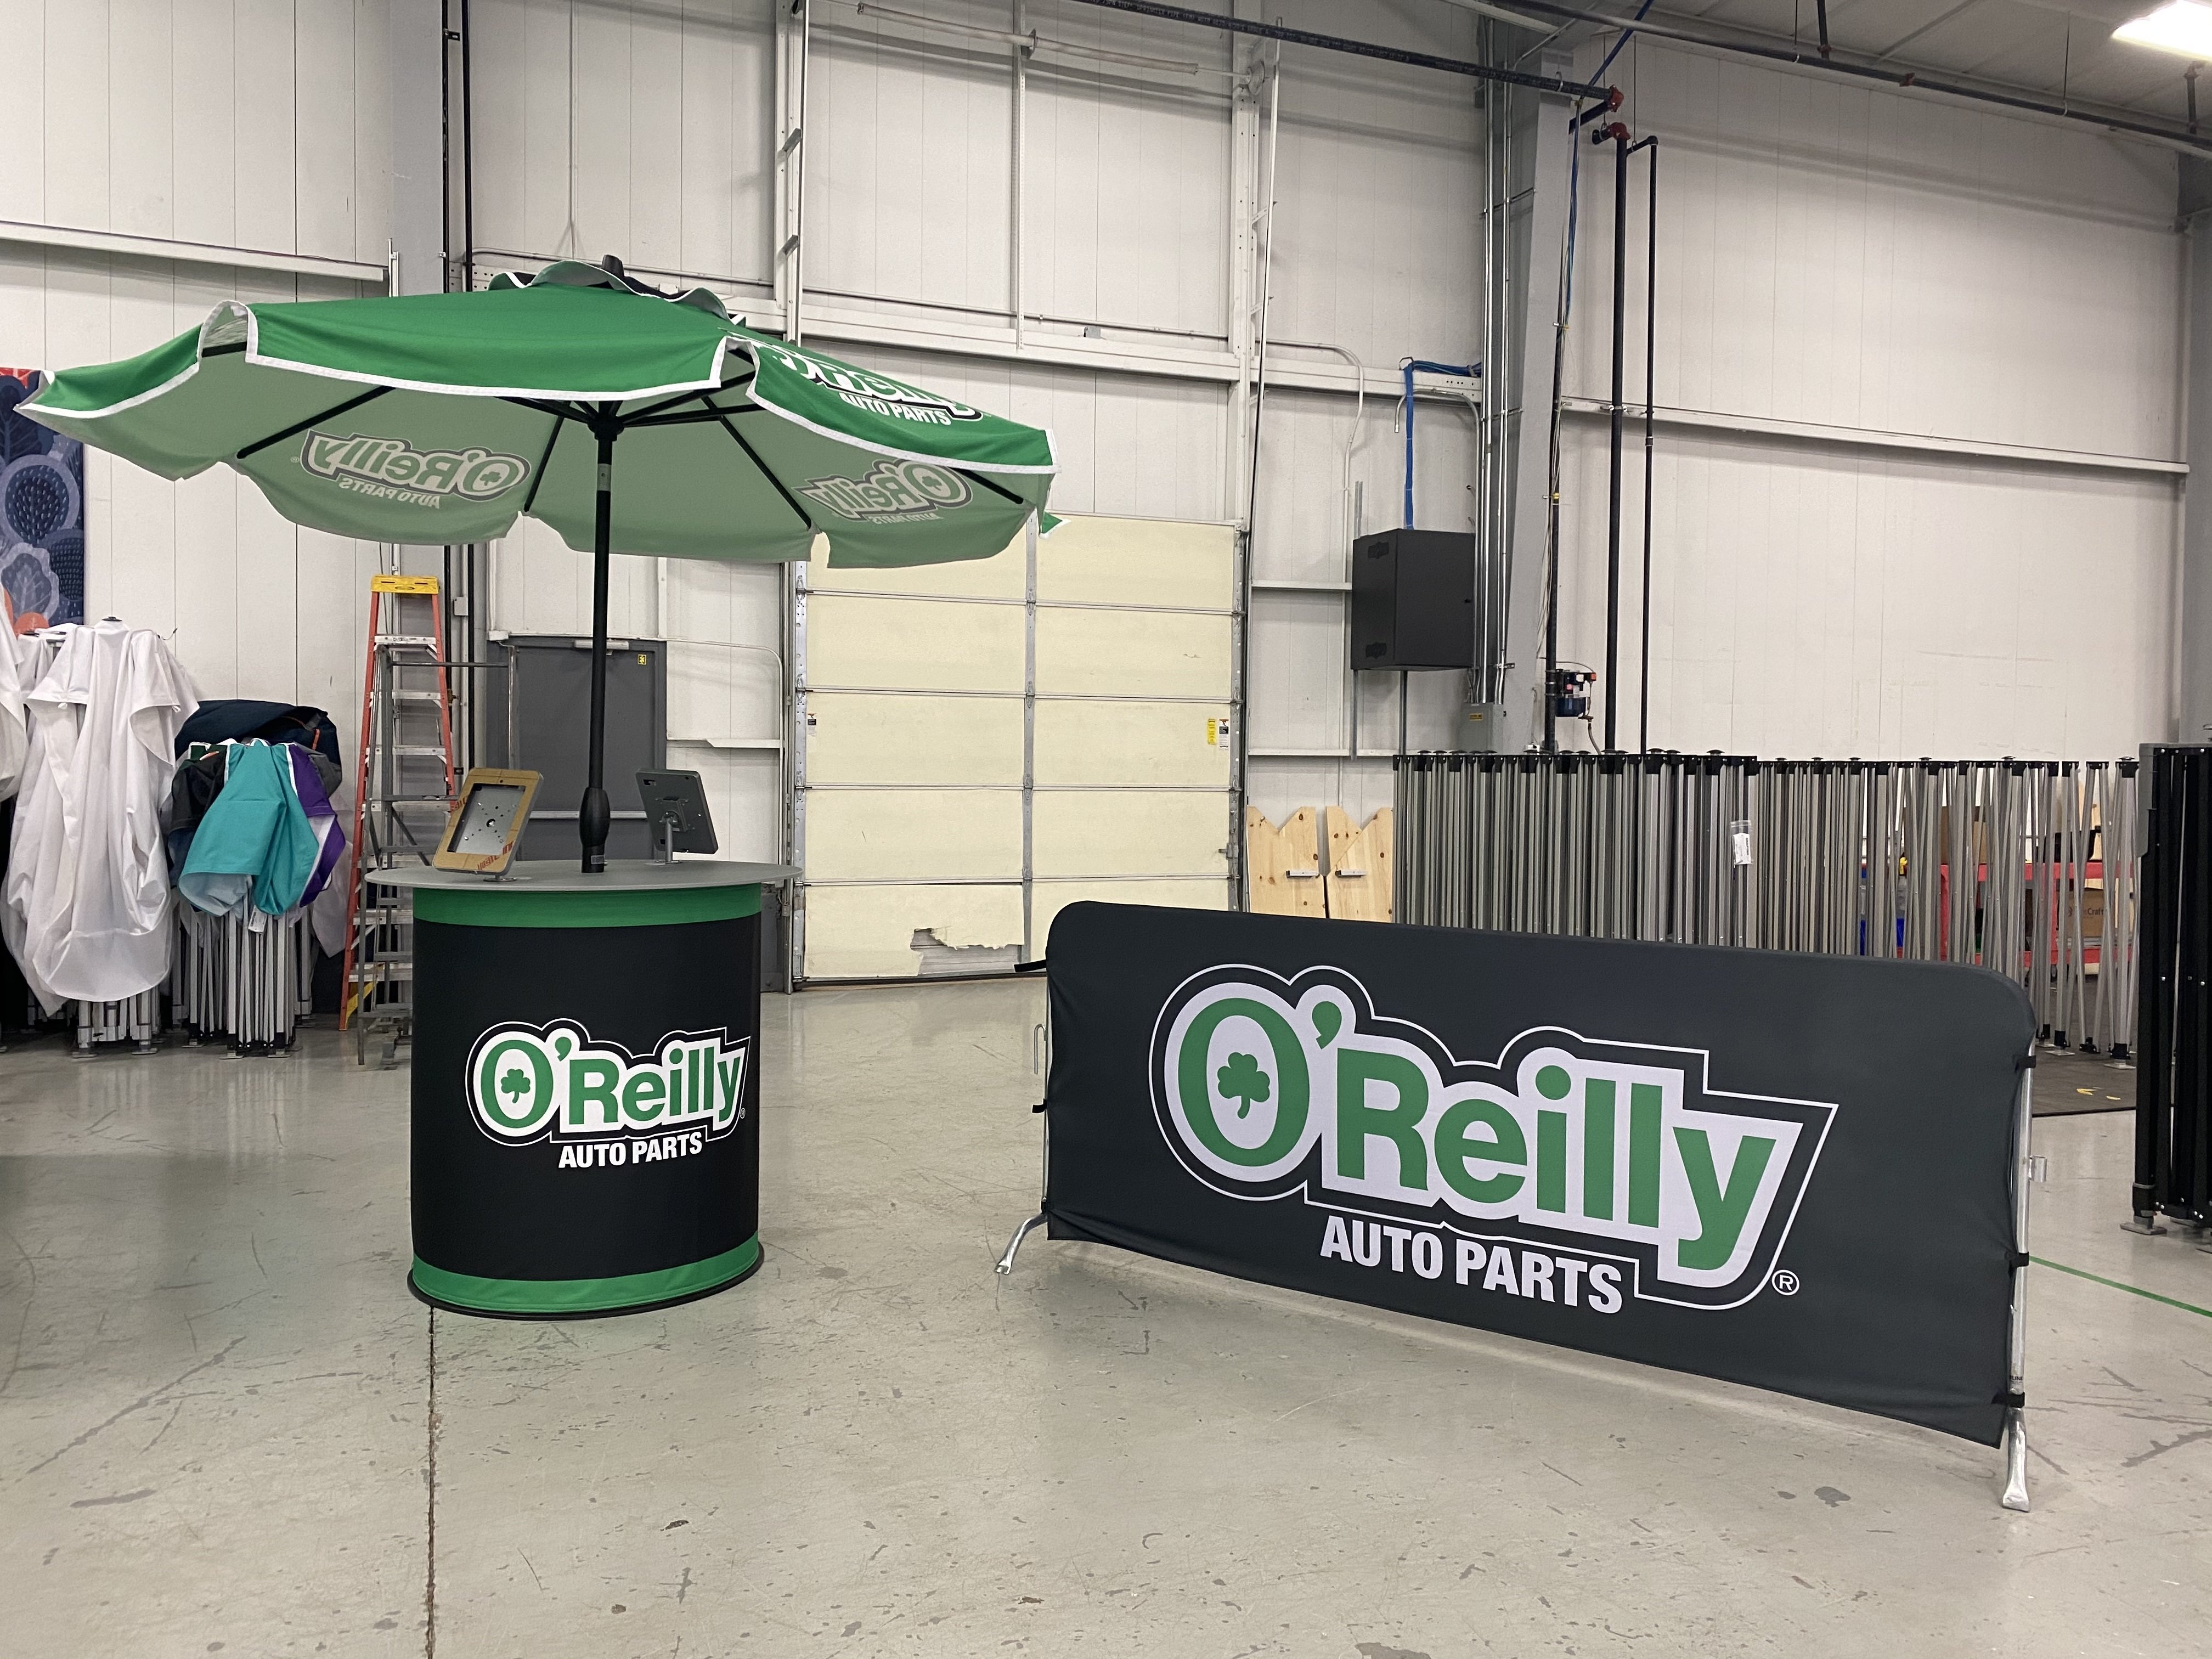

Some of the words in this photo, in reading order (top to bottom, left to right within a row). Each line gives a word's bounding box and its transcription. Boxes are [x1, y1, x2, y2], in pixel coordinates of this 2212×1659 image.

[839, 392, 890, 416] AUTO
[888, 402, 951, 426] PARTS
[480, 1035, 741, 1129] O'Reilly
[558, 1142, 627, 1169] AUTO
[632, 1131, 703, 1164] PARTS
[1177, 996, 1778, 1271] O'Reilly
[1320, 1215, 1443, 1280] AUTO
[1455, 1238, 1623, 1314] PARTS
